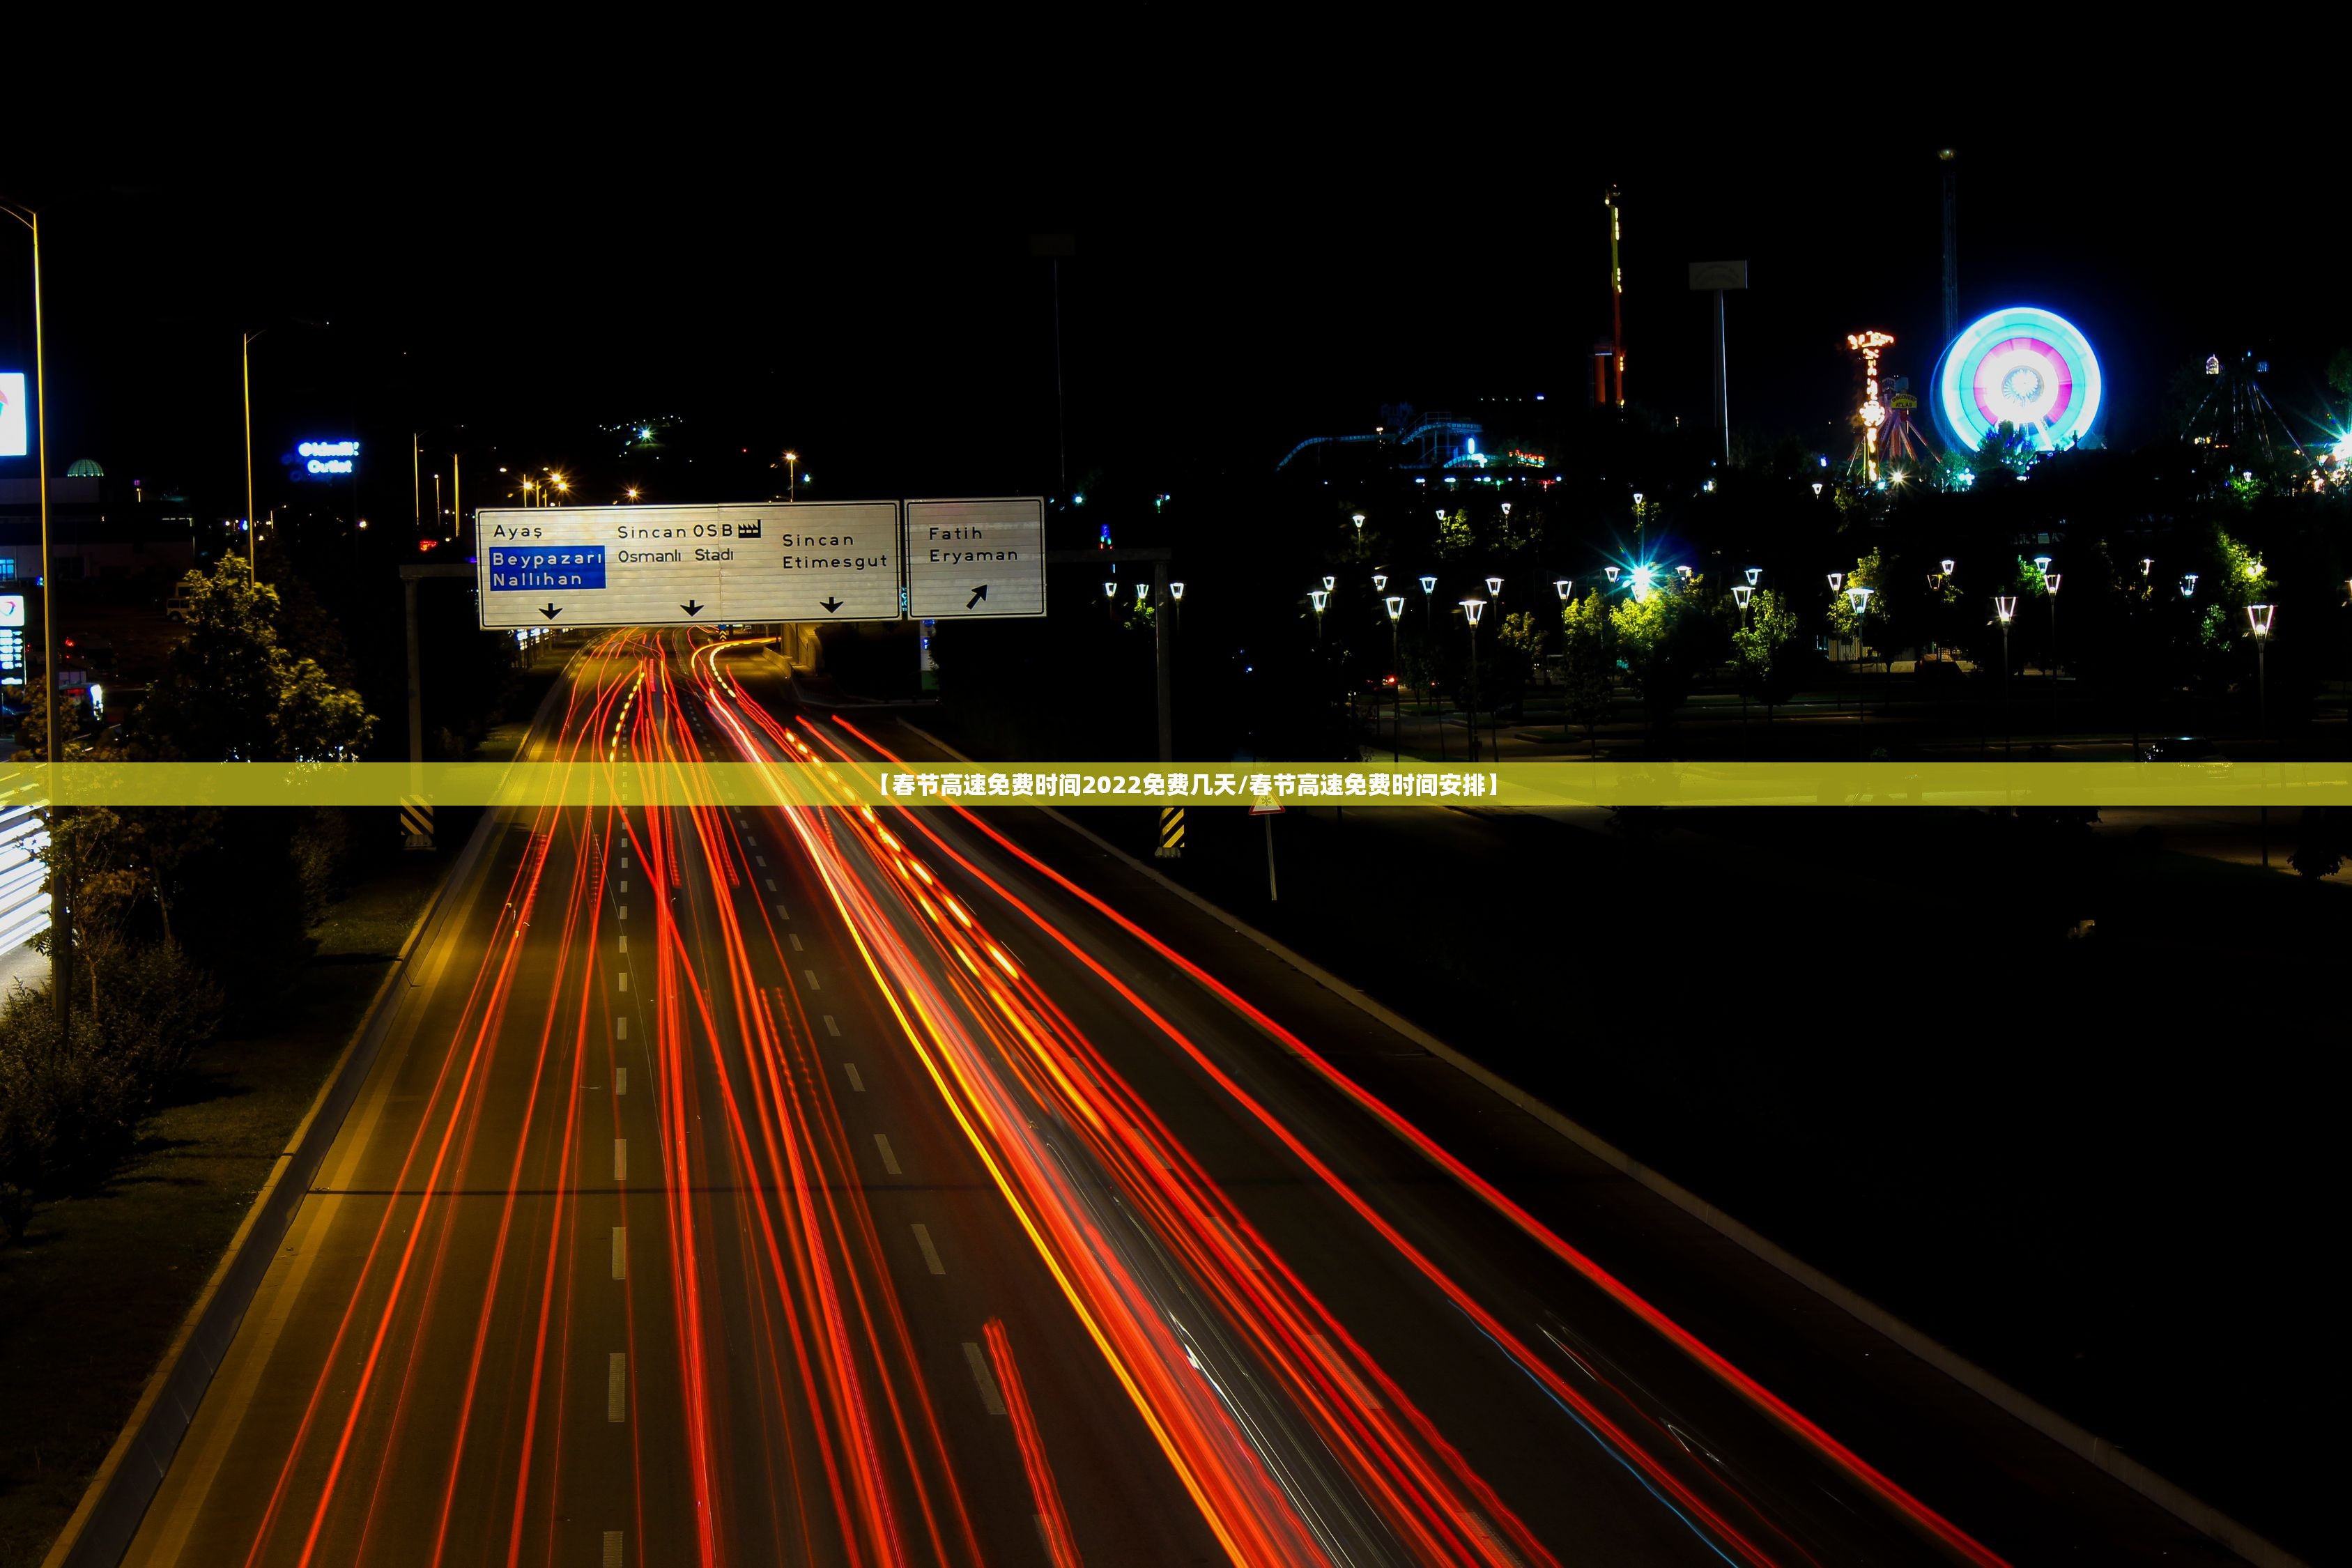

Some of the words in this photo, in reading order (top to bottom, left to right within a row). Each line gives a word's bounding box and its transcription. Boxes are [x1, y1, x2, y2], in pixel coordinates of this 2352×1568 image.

[493, 525, 542, 540] Ayaş
[617, 525, 686, 539] Sincan
[693, 524, 732, 537] OSB
[929, 527, 982, 540] Fatih
[783, 534, 854, 547] Sincan
[493, 553, 601, 569] Beypazarı
[618, 549, 682, 563] Osmanlı
[695, 548, 734, 561] Stadı
[783, 555, 887, 571] Etimesgut
[930, 549, 1017, 564] Eryaman
[493, 572, 582, 586] Nallıhan
